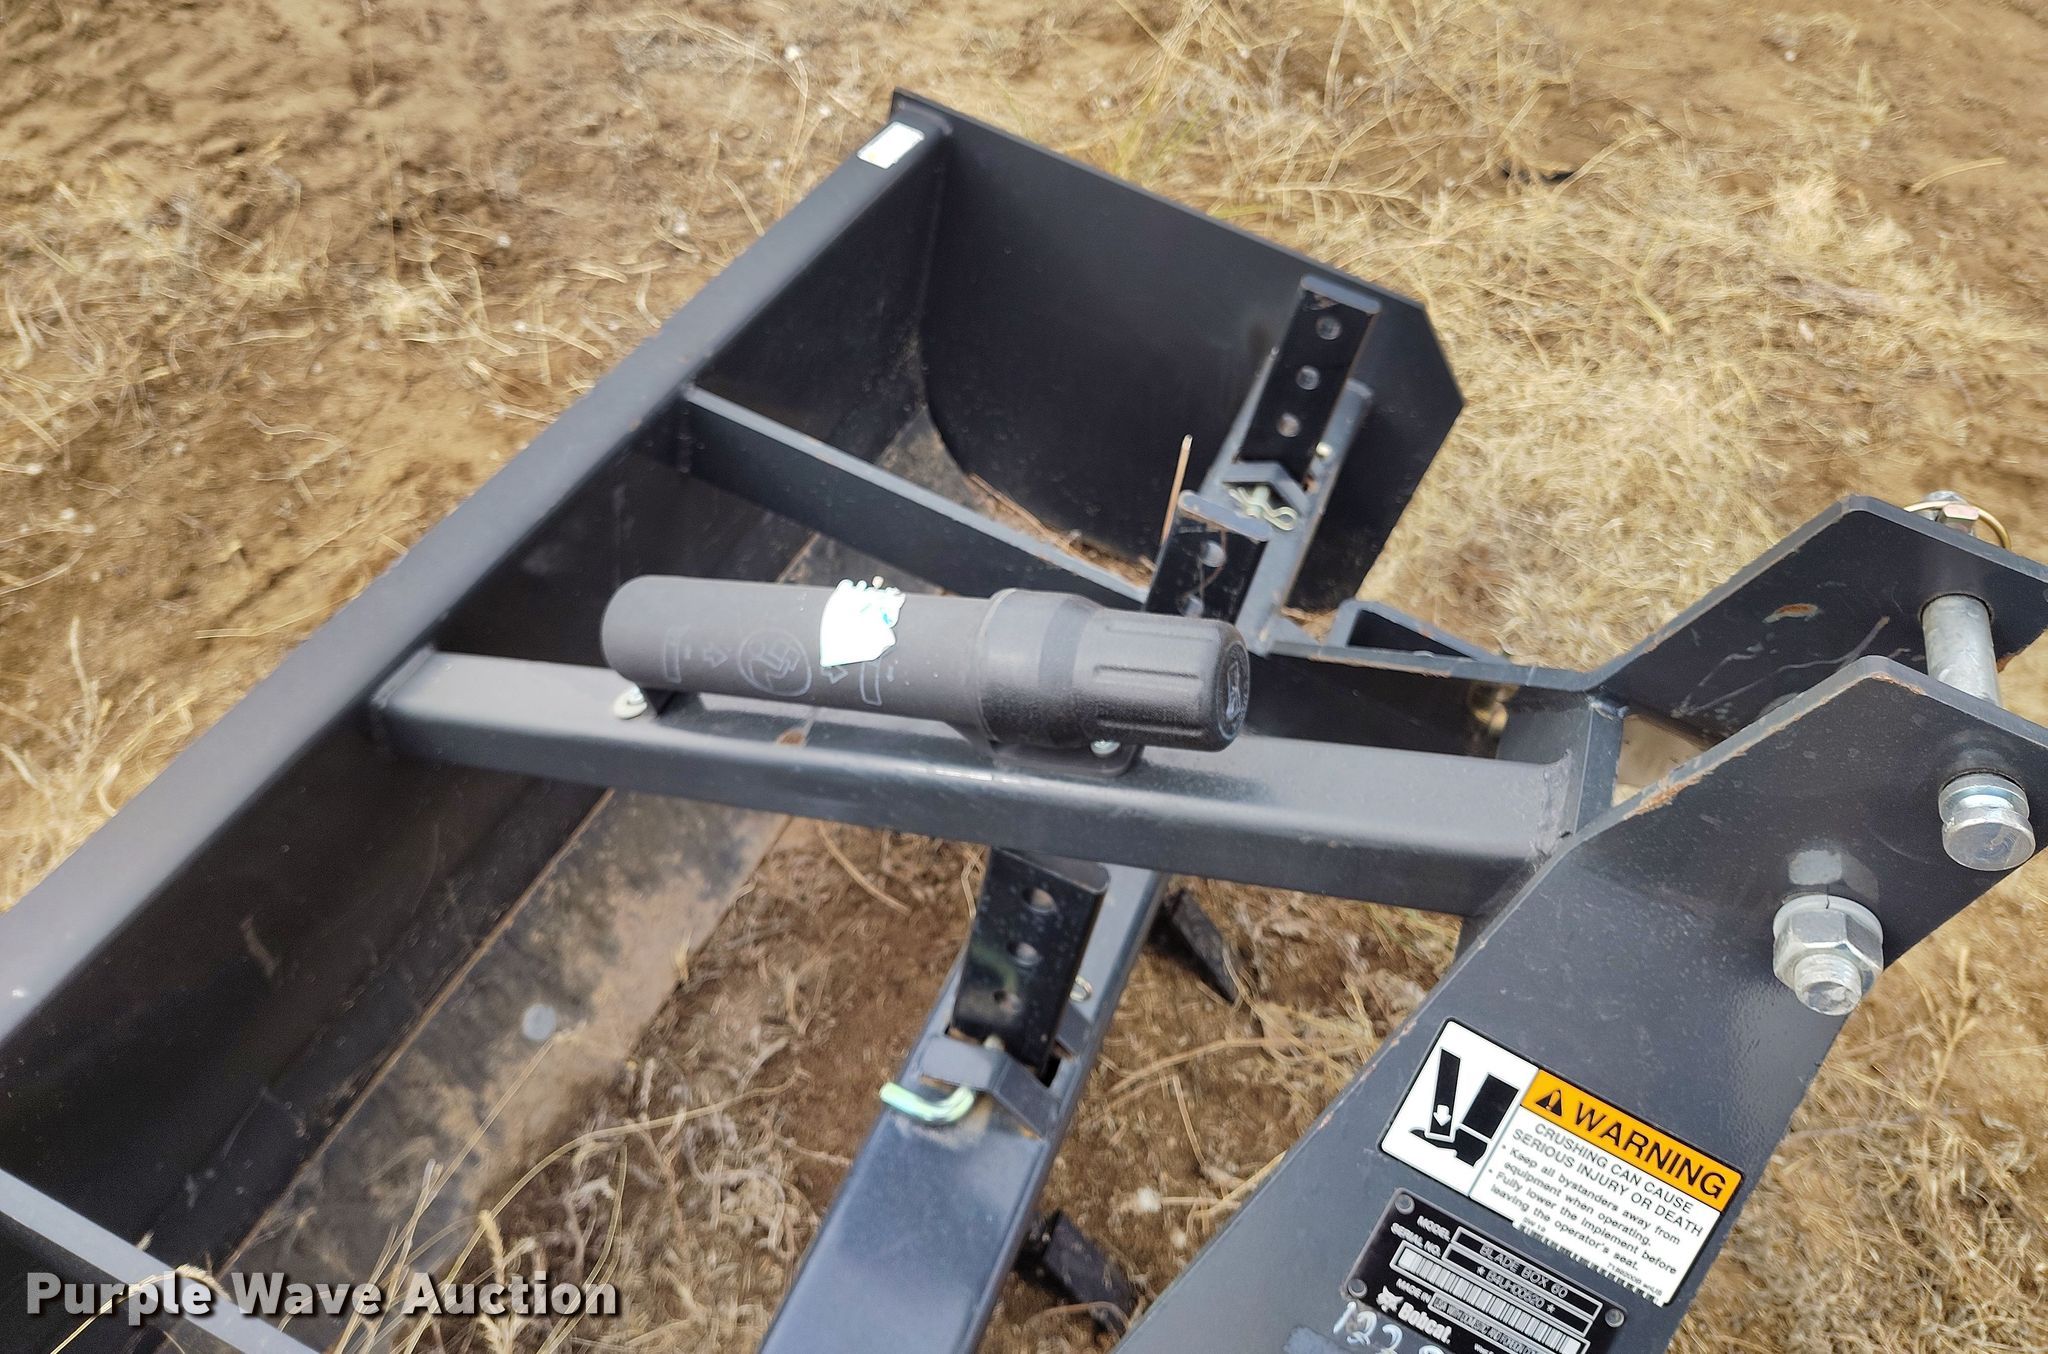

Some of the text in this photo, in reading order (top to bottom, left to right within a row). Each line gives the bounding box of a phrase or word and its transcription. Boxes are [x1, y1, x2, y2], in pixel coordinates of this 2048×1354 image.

[1512, 1128, 1704, 1238] SERIOUS INJURY OR DEATH
[1534, 1122, 1694, 1215] CRUSHING CAN CAUSE
[1576, 1102, 1726, 1199] WARNING
[1390, 1222, 1424, 1249] SERIAL
[1416, 1216, 1451, 1242] MODEL
[1490, 1183, 1640, 1272] leaving the operator's seat.
[1495, 1170, 1524, 1194] Fully
[1525, 1187, 1558, 1210] lower
[1559, 1205, 1579, 1222] the
[1580, 1217, 1640, 1255] implement
[1640, 1249, 1678, 1275] before
[1503, 1161, 1652, 1248] equipment when operating.
[1509, 1146, 1681, 1246] Keep all bystanders away from
[1395, 1278, 1433, 1304] MADE IN
[1479, 1244, 1569, 1299] BLADE BOX 60
